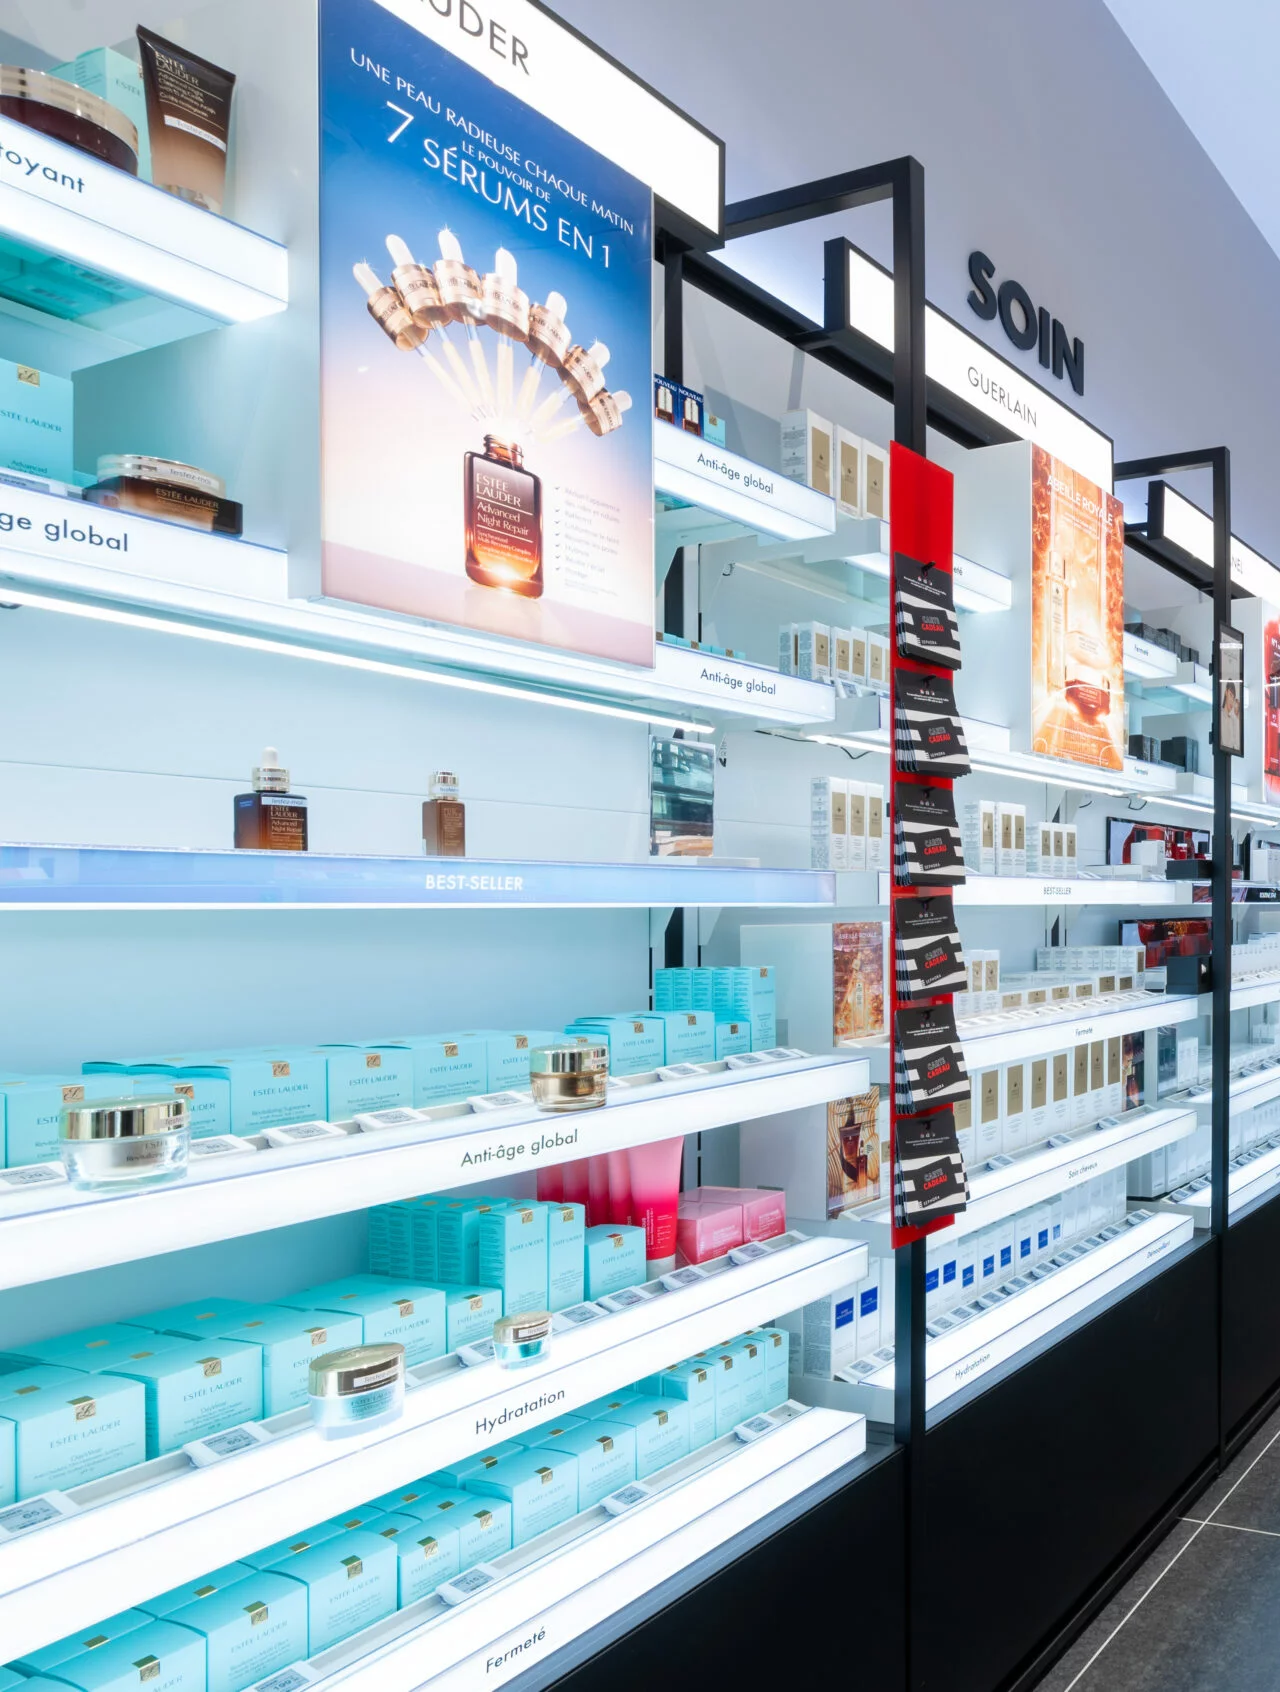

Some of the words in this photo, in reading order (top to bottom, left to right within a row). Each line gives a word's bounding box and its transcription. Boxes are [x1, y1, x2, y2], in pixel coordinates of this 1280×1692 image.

[350, 47, 391, 85] UNE
[397, 76, 441, 114] PEAU
[446, 108, 521, 166] RADIEUSE
[525, 160, 588, 207] CHAQUE
[592, 200, 634, 235] MATIN
[386, 101, 415, 143] 7
[423, 138, 548, 232] SÉRUMS
[558, 217, 593, 259] EN
[602, 245, 609, 268] 1
[462, 140, 475, 157] LE
[478, 149, 533, 193] POUVOIR
[536, 186, 551, 203] DE
[967, 250, 1084, 397] SOIN
[967, 366, 1037, 428] GUERLAIN
[25, 416, 62, 432] LAUDER
[697, 453, 740, 481] Anti-âge
[743, 474, 774, 495] global
[183, 493, 220, 509] LAUDER
[476, 484, 521, 507] LAUDER
[1047, 475, 1081, 506] ABEILLE
[1082, 496, 1113, 526] ROYALE
[477, 501, 520, 523] Advanced
[477, 512, 501, 527] Night
[503, 521, 529, 536] Repair
[44, 519, 129, 551] global
[700, 668, 743, 690] Anti-âge
[746, 678, 776, 695] global
[425, 874, 523, 892] BEST-SELLER
[1043, 886, 1071, 895] BEST-SELLER
[278, 1083, 309, 1094] LAUDER
[461, 1144, 526, 1167] Anti-âge
[531, 1129, 578, 1156] global
[954, 1353, 991, 1380] Hydratation
[210, 1376, 243, 1395] LAUDER
[475, 1387, 566, 1436] Hydratation
[81, 1419, 121, 1441] LAUDER
[256, 1619, 289, 1642] LAUDER
[486, 1626, 547, 1674] Fermeté
